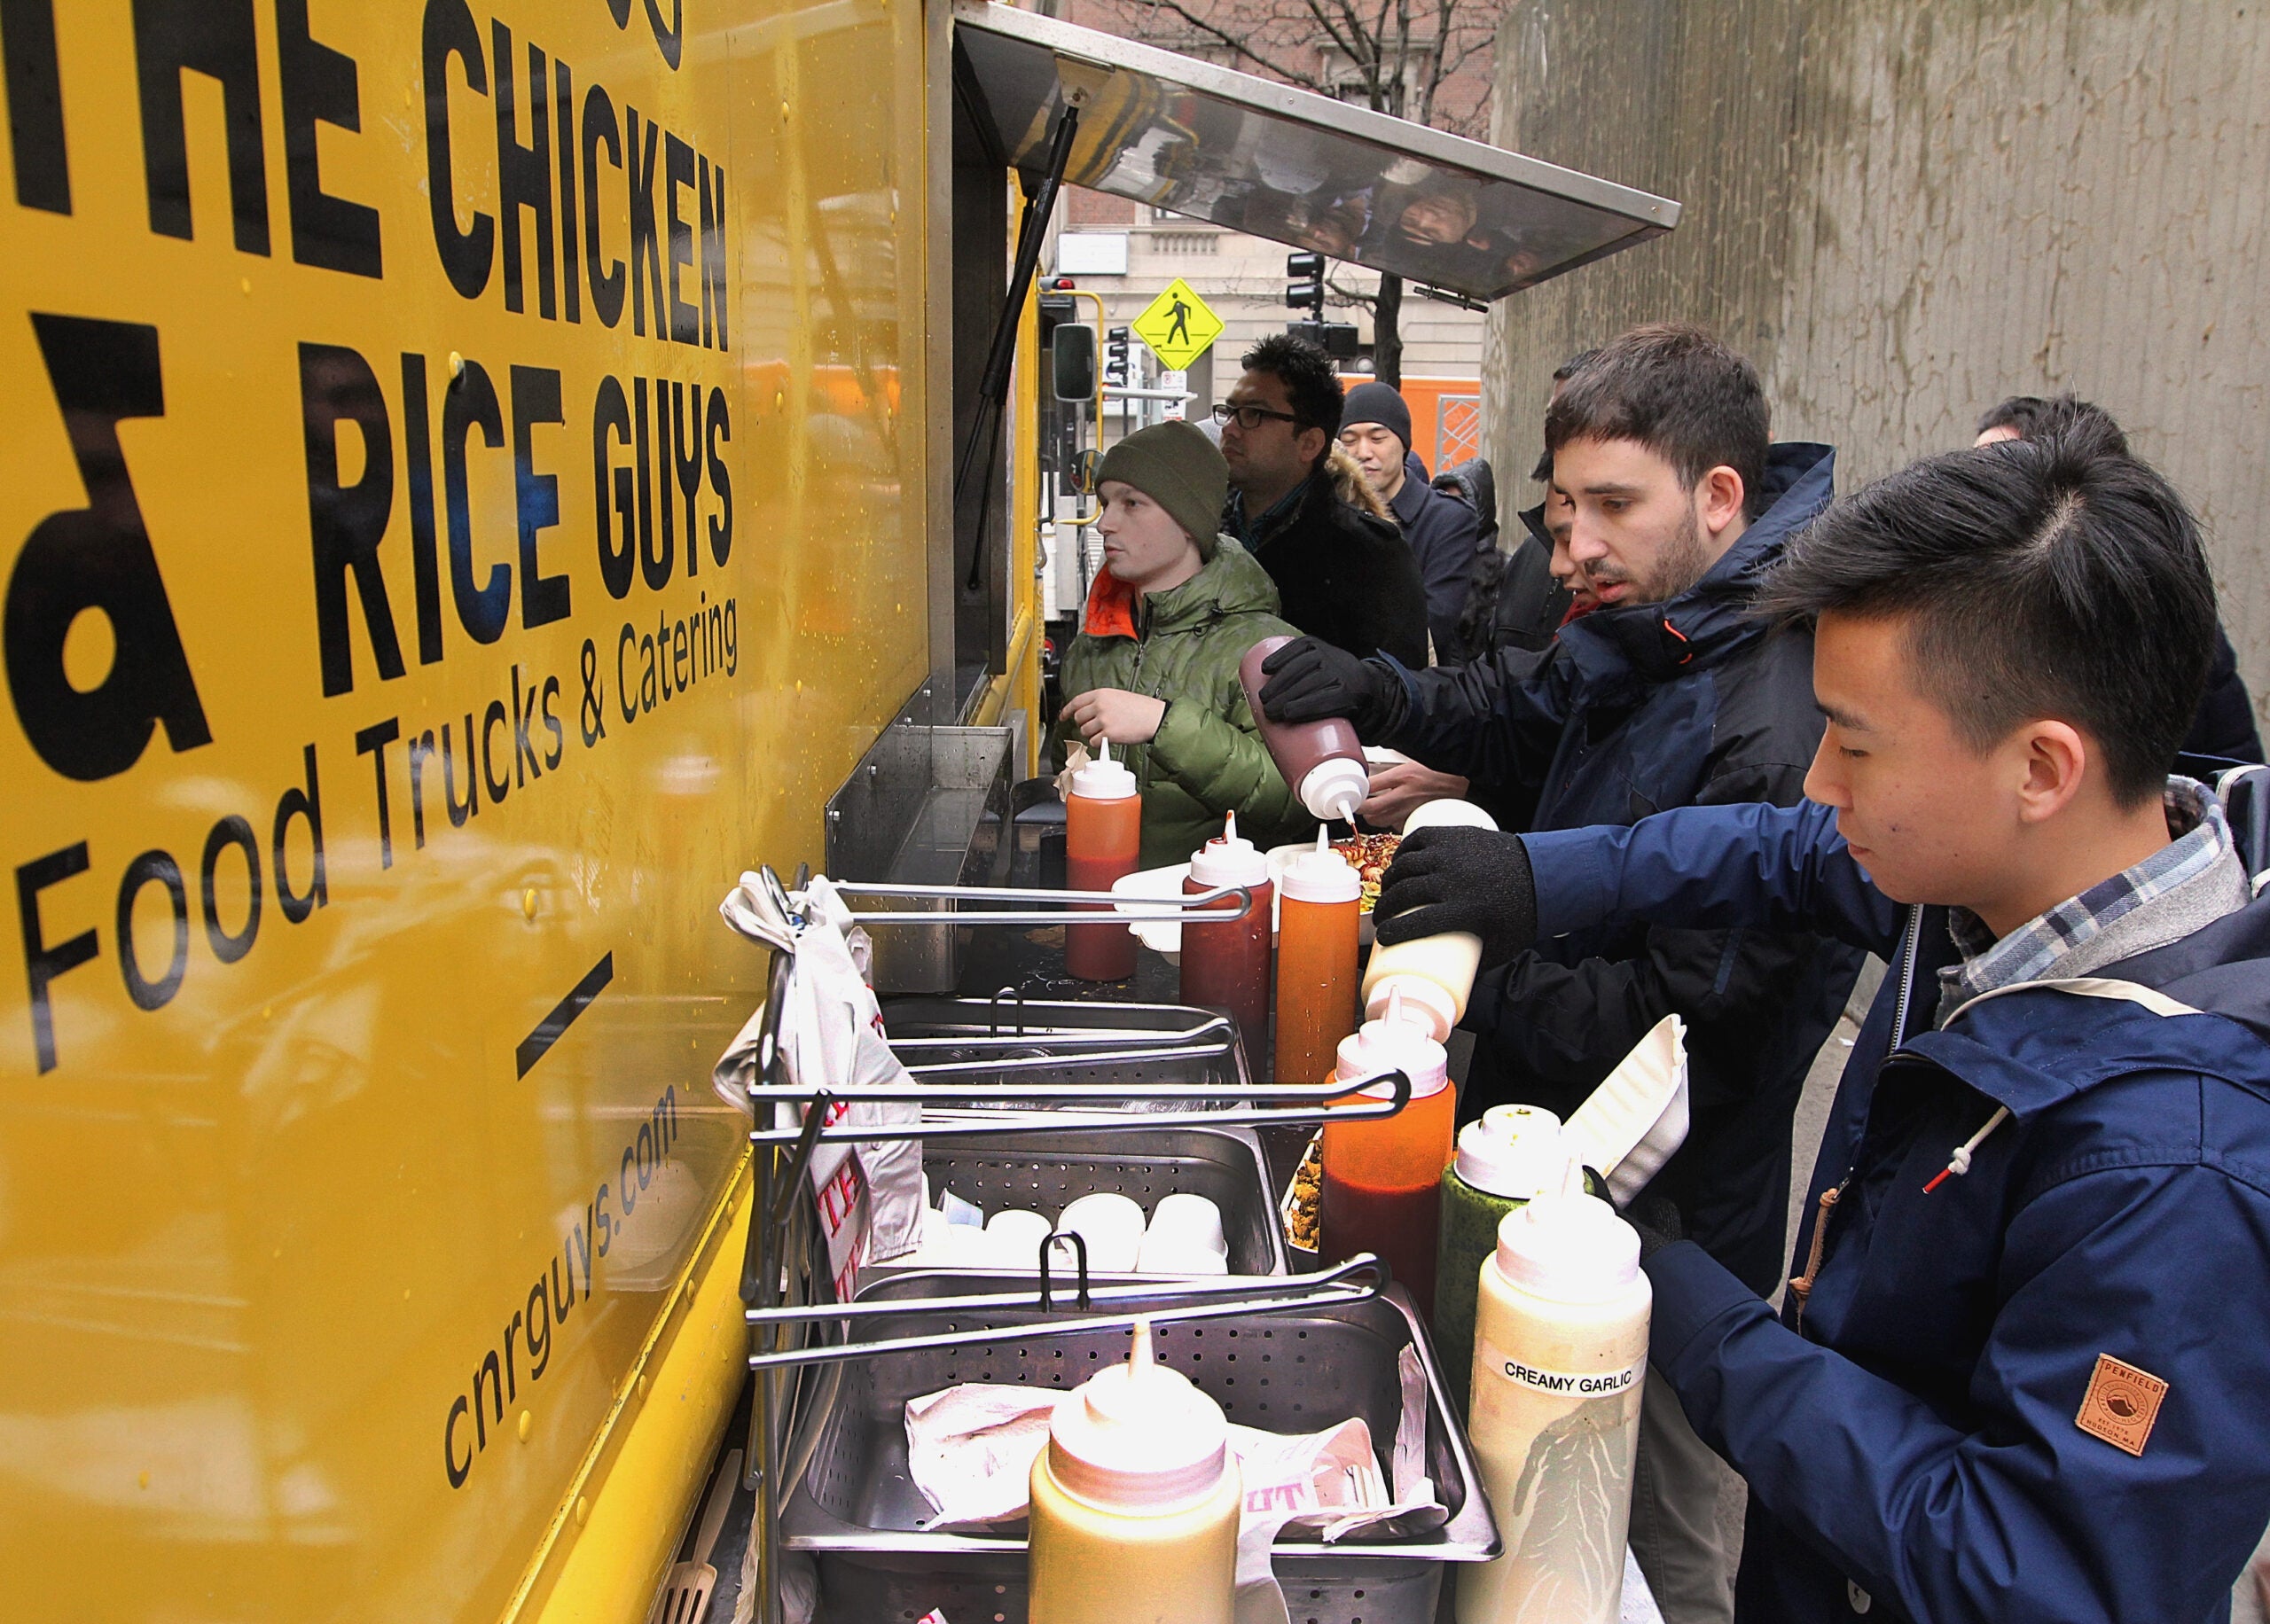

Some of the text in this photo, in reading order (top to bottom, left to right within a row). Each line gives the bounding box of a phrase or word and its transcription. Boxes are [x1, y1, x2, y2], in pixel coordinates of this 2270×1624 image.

[423, 0, 729, 353] CHICKEN
[298, 341, 571, 699] RICE
[593, 375, 733, 600] GUYS
[15, 590, 738, 1076] Food Trucks & Catering
[444, 1083, 677, 1490] cnrguys.com
[1505, 1362, 1632, 1393] CREAMY GARLIC
[2105, 1363, 2158, 1392] PENFIELD
